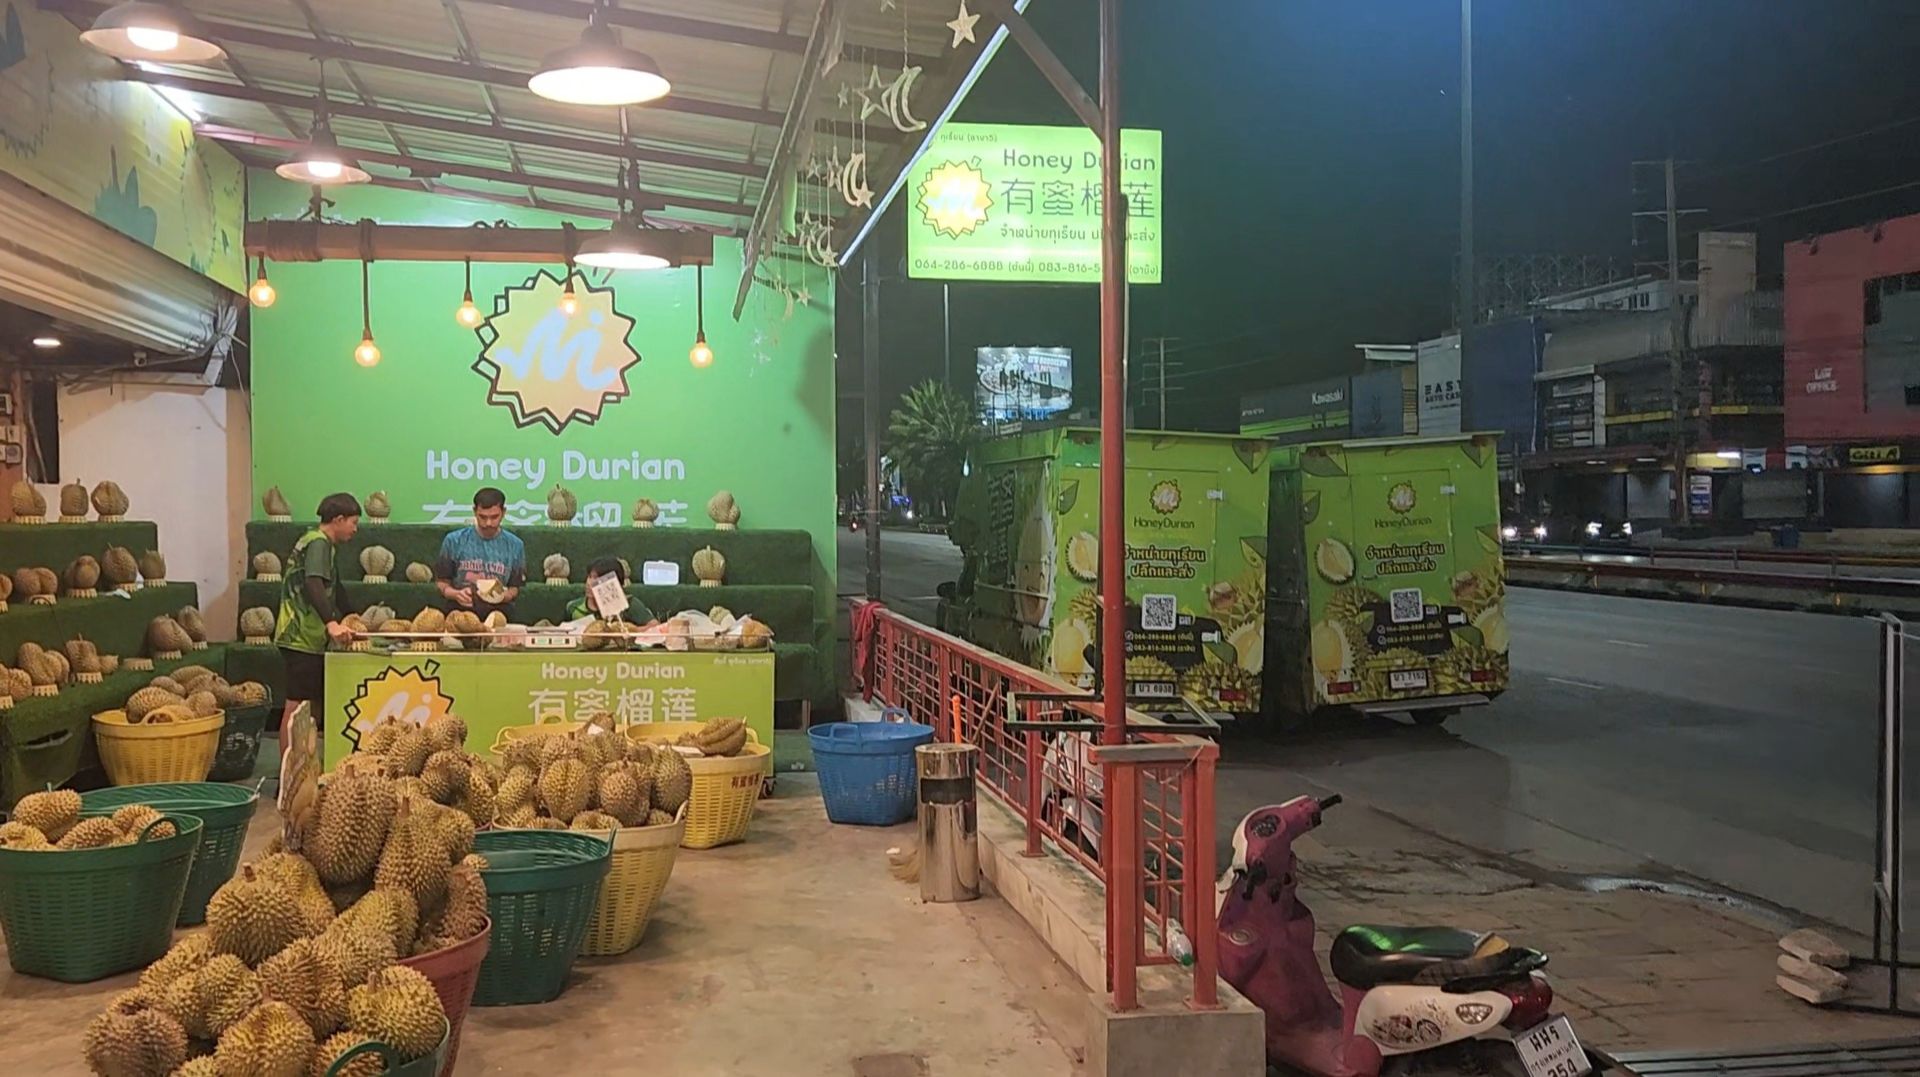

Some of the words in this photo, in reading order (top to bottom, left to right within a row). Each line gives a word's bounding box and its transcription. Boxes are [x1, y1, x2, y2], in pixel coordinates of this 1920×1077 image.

[1003, 149, 1073, 174] Honey
[1083, 151, 1156, 171] Dian
[426, 450, 546, 490] Honey
[562, 450, 686, 481] Durian
[542, 662, 607, 684] Honey
[616, 662, 685, 679] Durian
